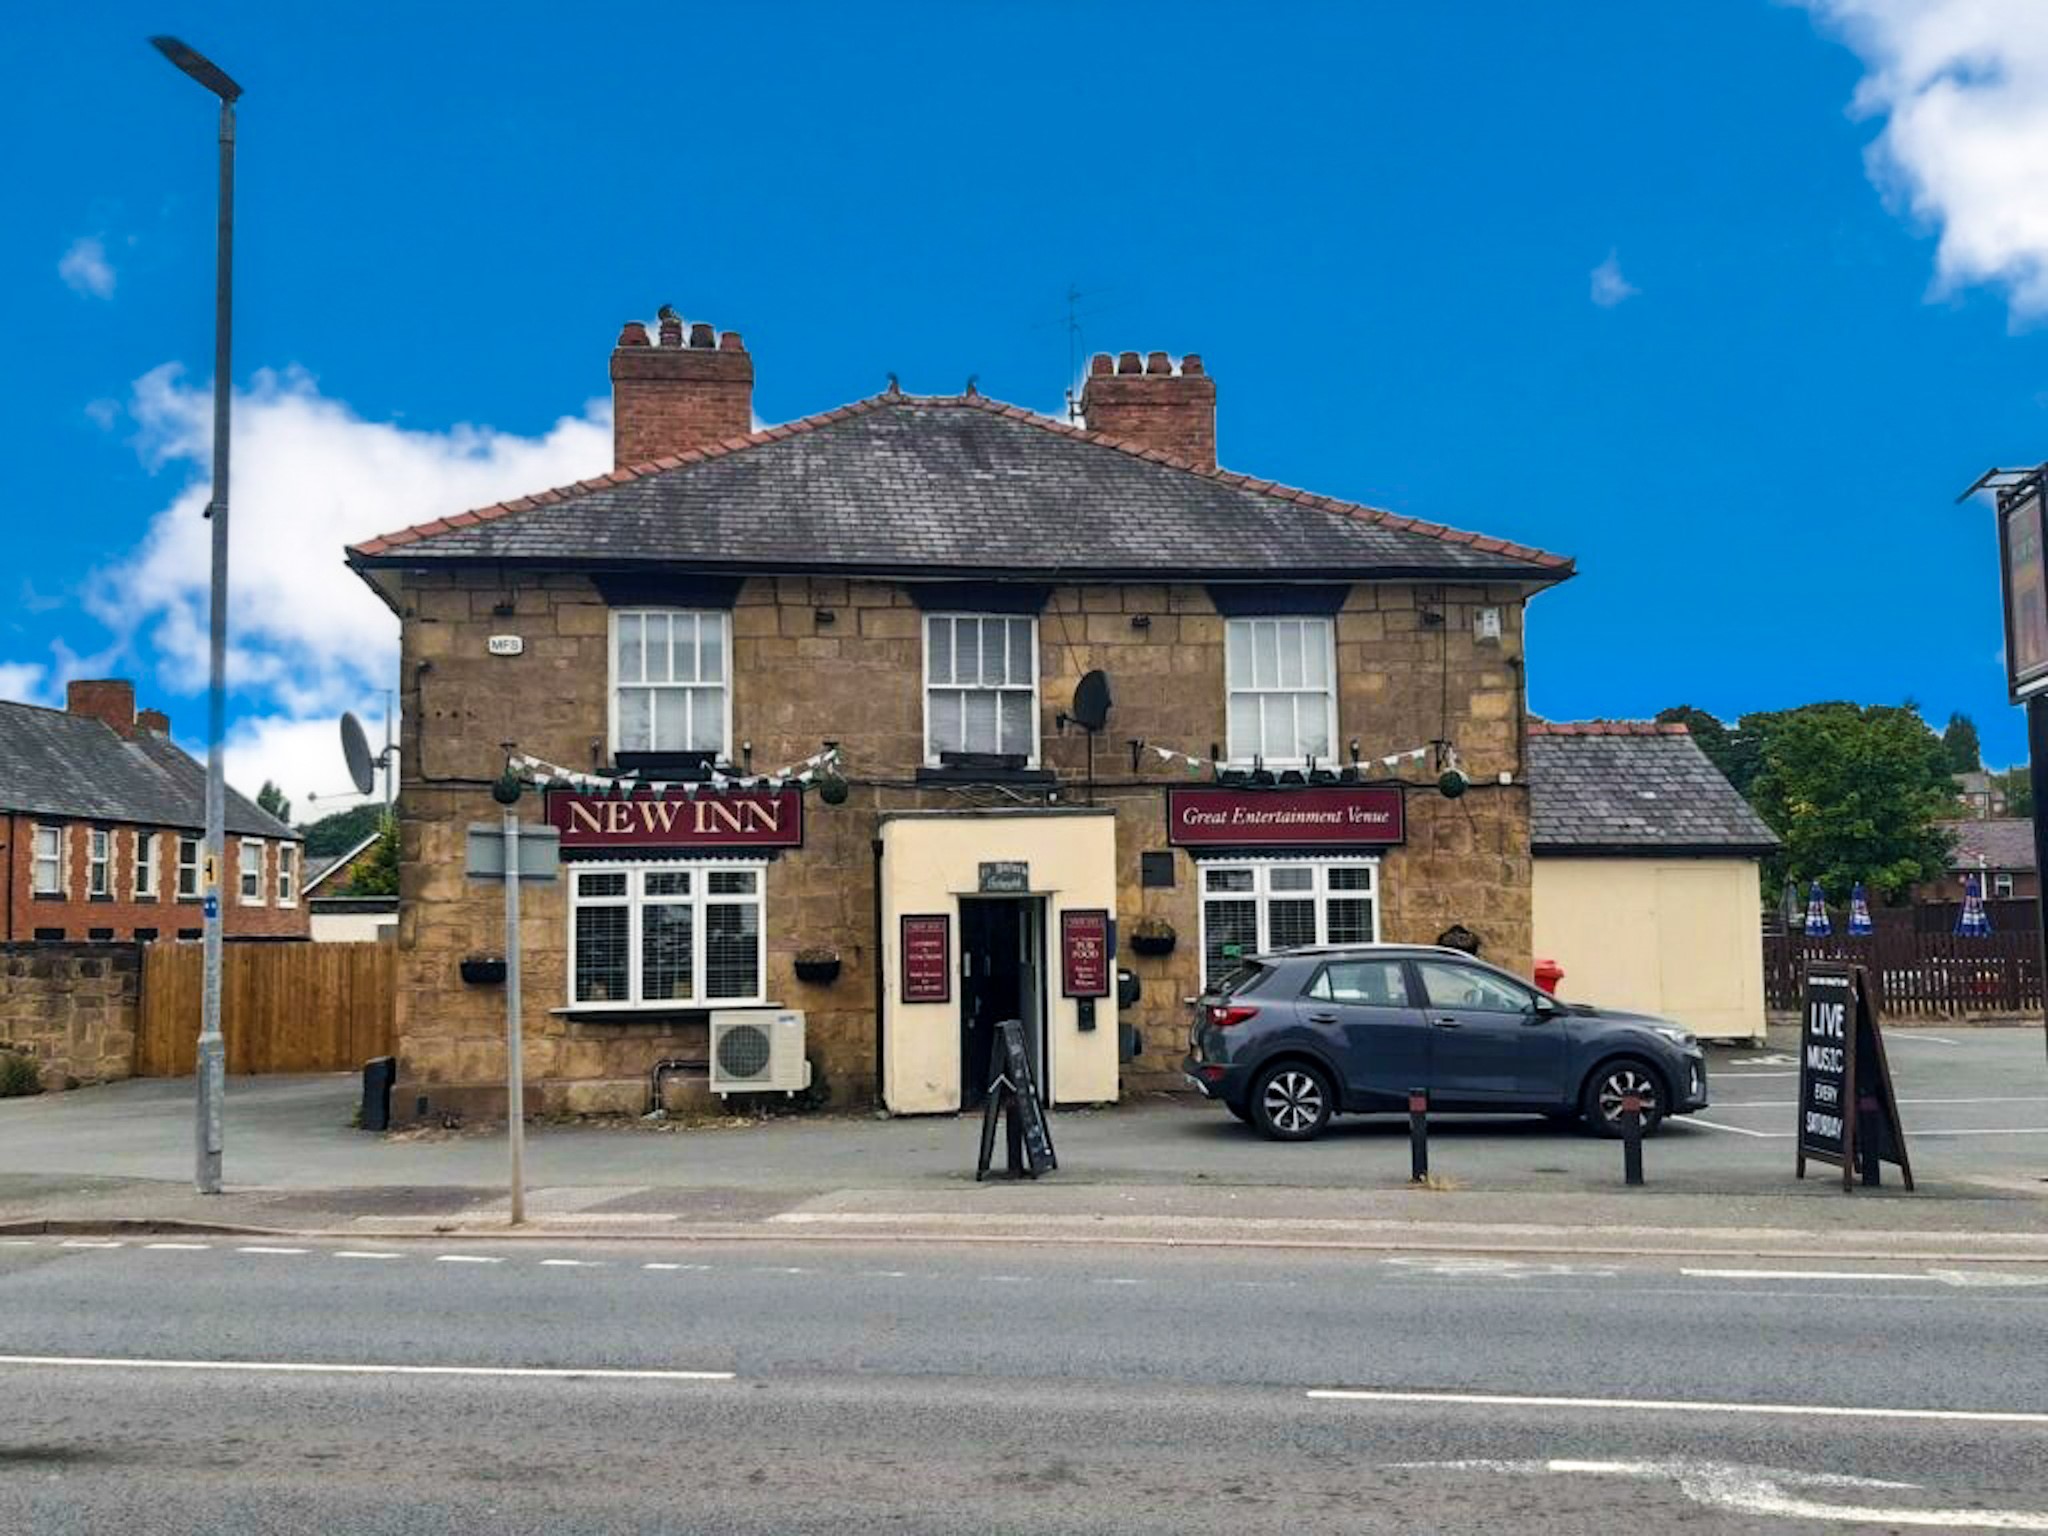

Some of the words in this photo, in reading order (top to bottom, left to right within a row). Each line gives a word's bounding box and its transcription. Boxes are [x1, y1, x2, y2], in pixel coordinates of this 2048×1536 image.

[491, 640, 519, 651] MFS
[568, 800, 684, 834] NEW
[693, 800, 782, 834] INN
[1182, 806, 1228, 825] Great
[1232, 806, 1342, 825] Entertainment
[1347, 805, 1391, 824] Venue
[1810, 1002, 1844, 1038] LIVE
[1807, 1045, 1844, 1074] MUSIC
[1814, 1083, 1839, 1104] EVERY
